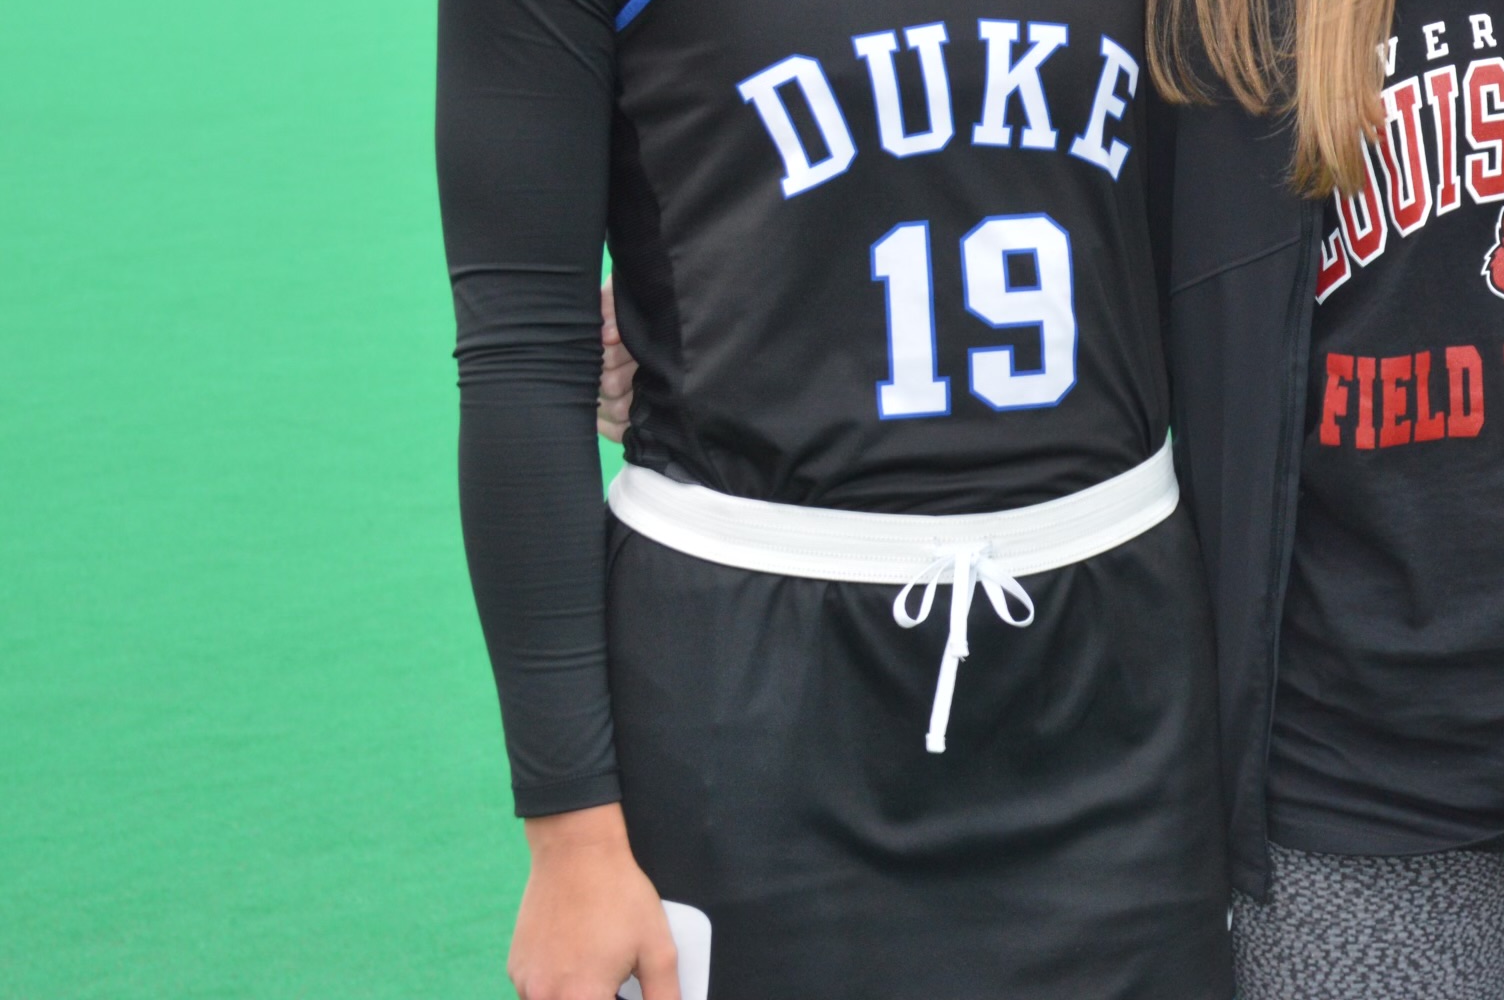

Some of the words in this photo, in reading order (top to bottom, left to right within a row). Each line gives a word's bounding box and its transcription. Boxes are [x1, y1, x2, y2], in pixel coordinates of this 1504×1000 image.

[736, 18, 1140, 199] DUKE
[870, 212, 1079, 420] 19
[1319, 344, 1485, 450] FIELD
